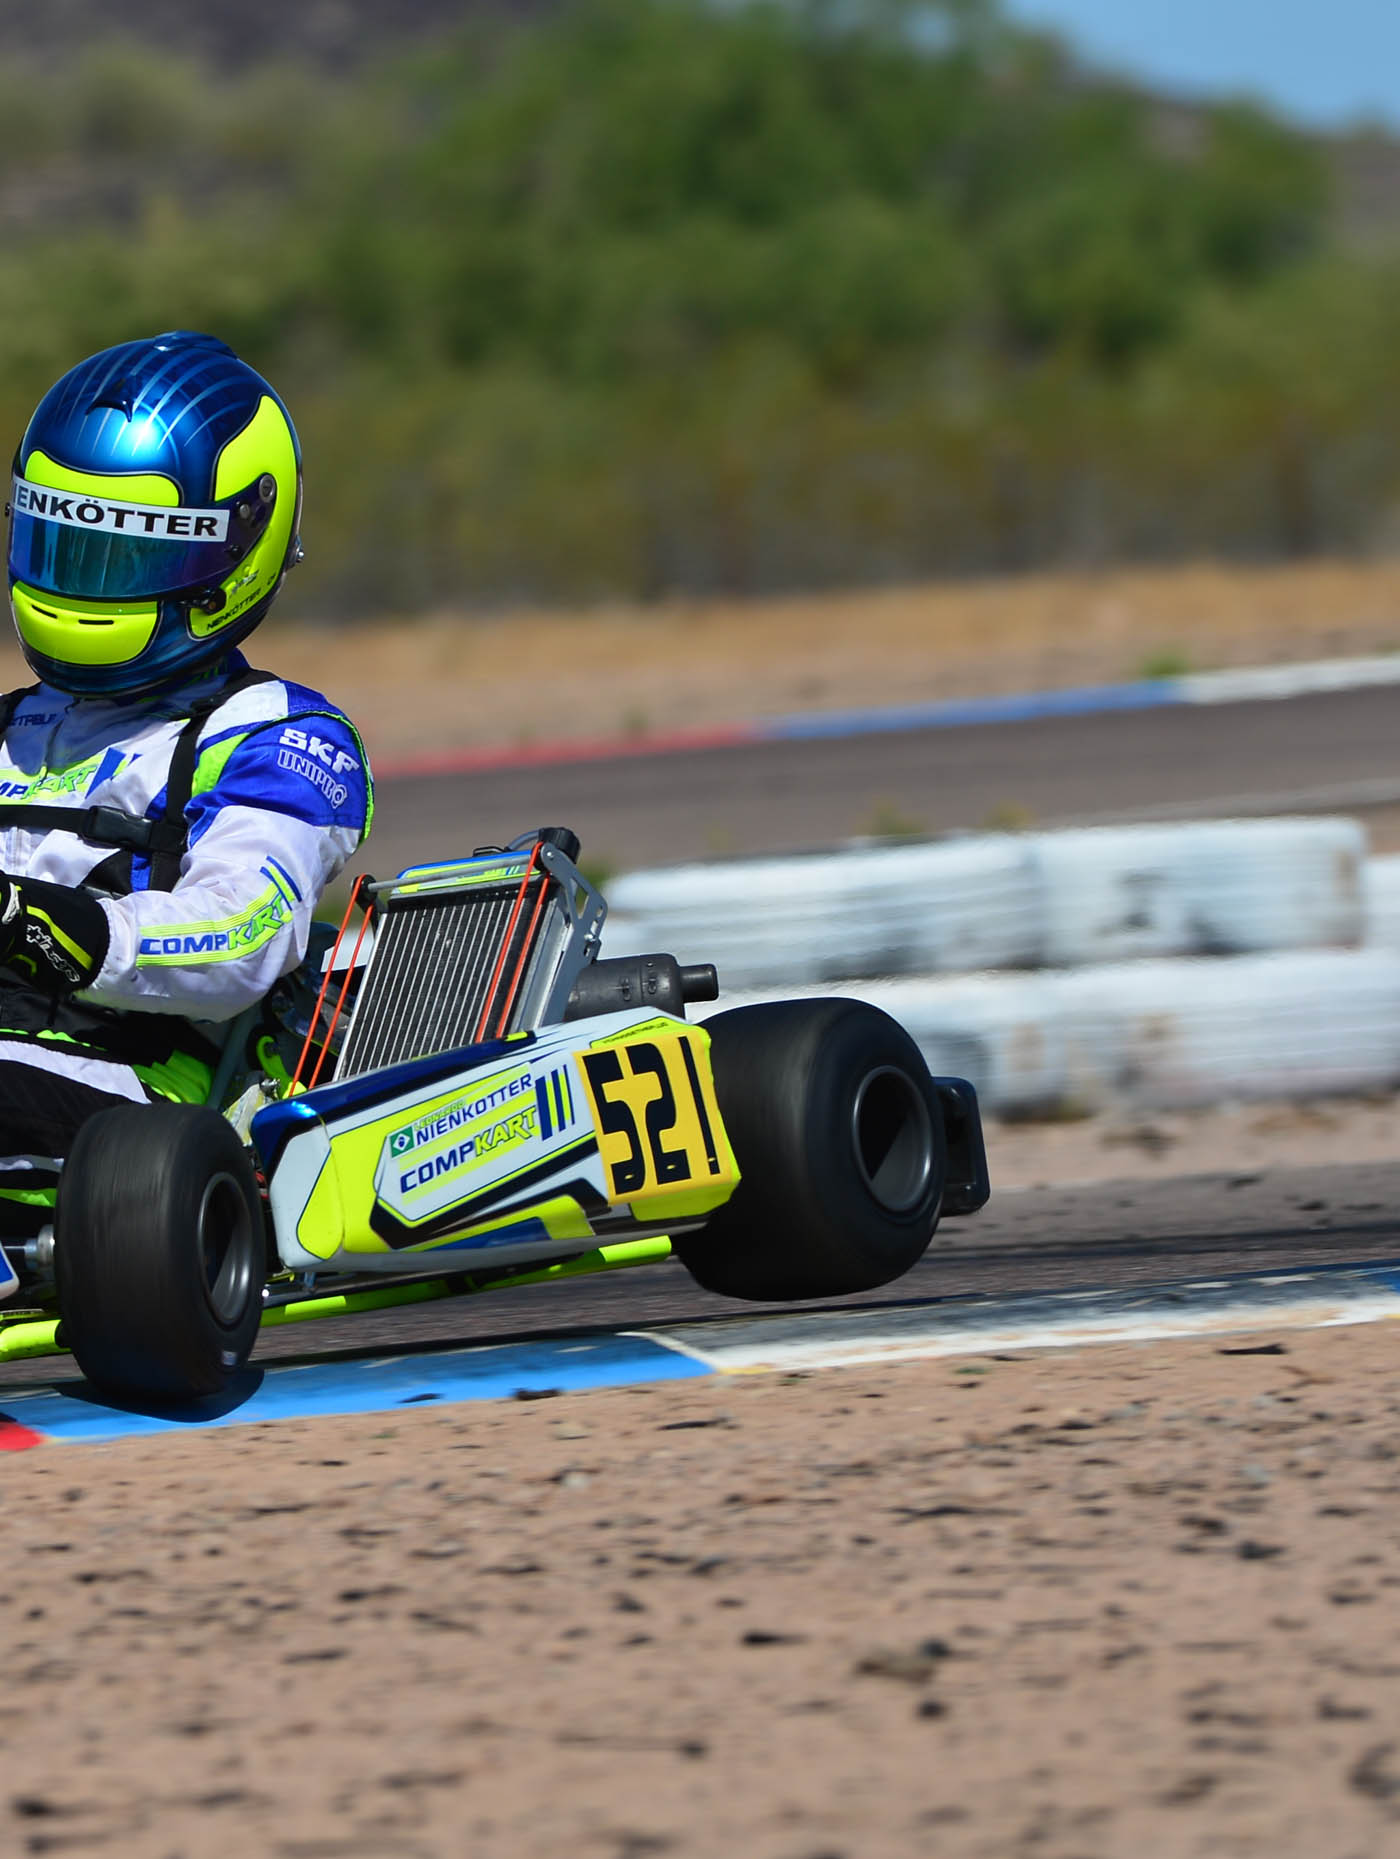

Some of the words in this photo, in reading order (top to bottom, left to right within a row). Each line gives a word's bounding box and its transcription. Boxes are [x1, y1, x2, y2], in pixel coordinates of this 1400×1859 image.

[277, 749, 348, 809] UNIPRO
[279, 728, 359, 774] SKF
[140, 892, 283, 955] COMPKART
[416, 1073, 532, 1146] NIENKOTTER
[582, 1036, 721, 1196] 521
[400, 1105, 537, 1194] COMPKART
